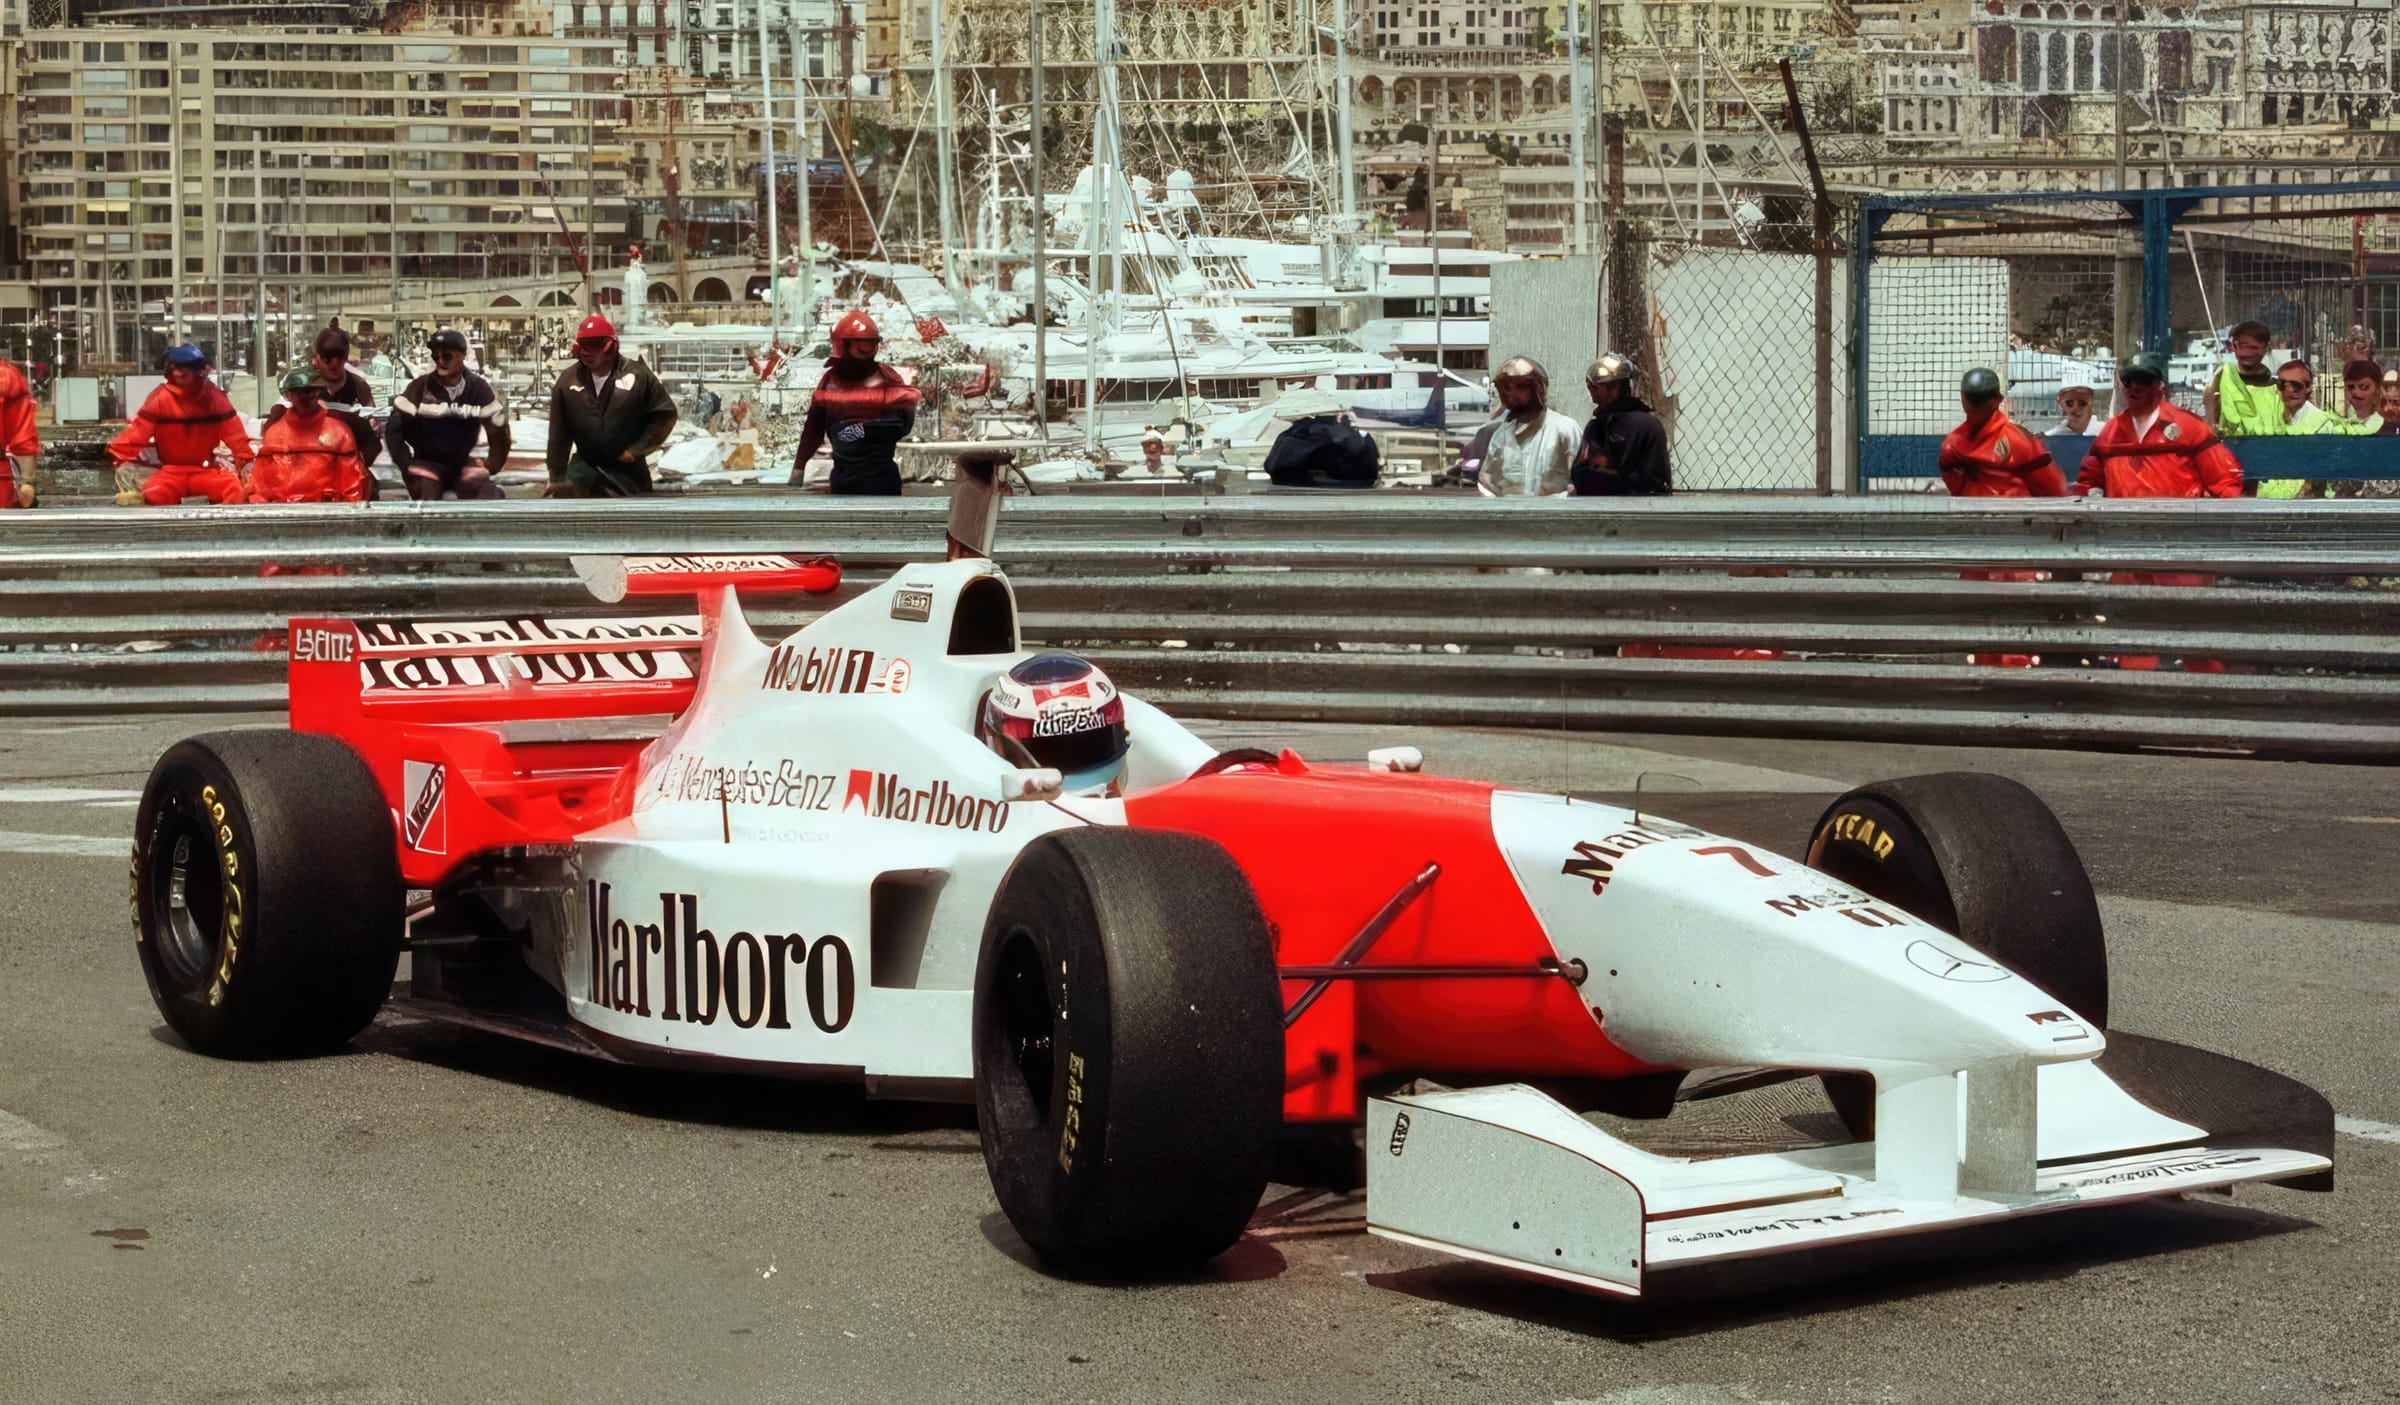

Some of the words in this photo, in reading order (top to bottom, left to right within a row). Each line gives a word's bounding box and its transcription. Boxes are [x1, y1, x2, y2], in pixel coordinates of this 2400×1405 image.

[762, 645, 843, 694] Mobil
[839, 649, 874, 693] 1
[872, 772, 1009, 834] Marlboro
[1688, 845, 1780, 878] 7
[588, 879, 856, 1034] Marlboro
